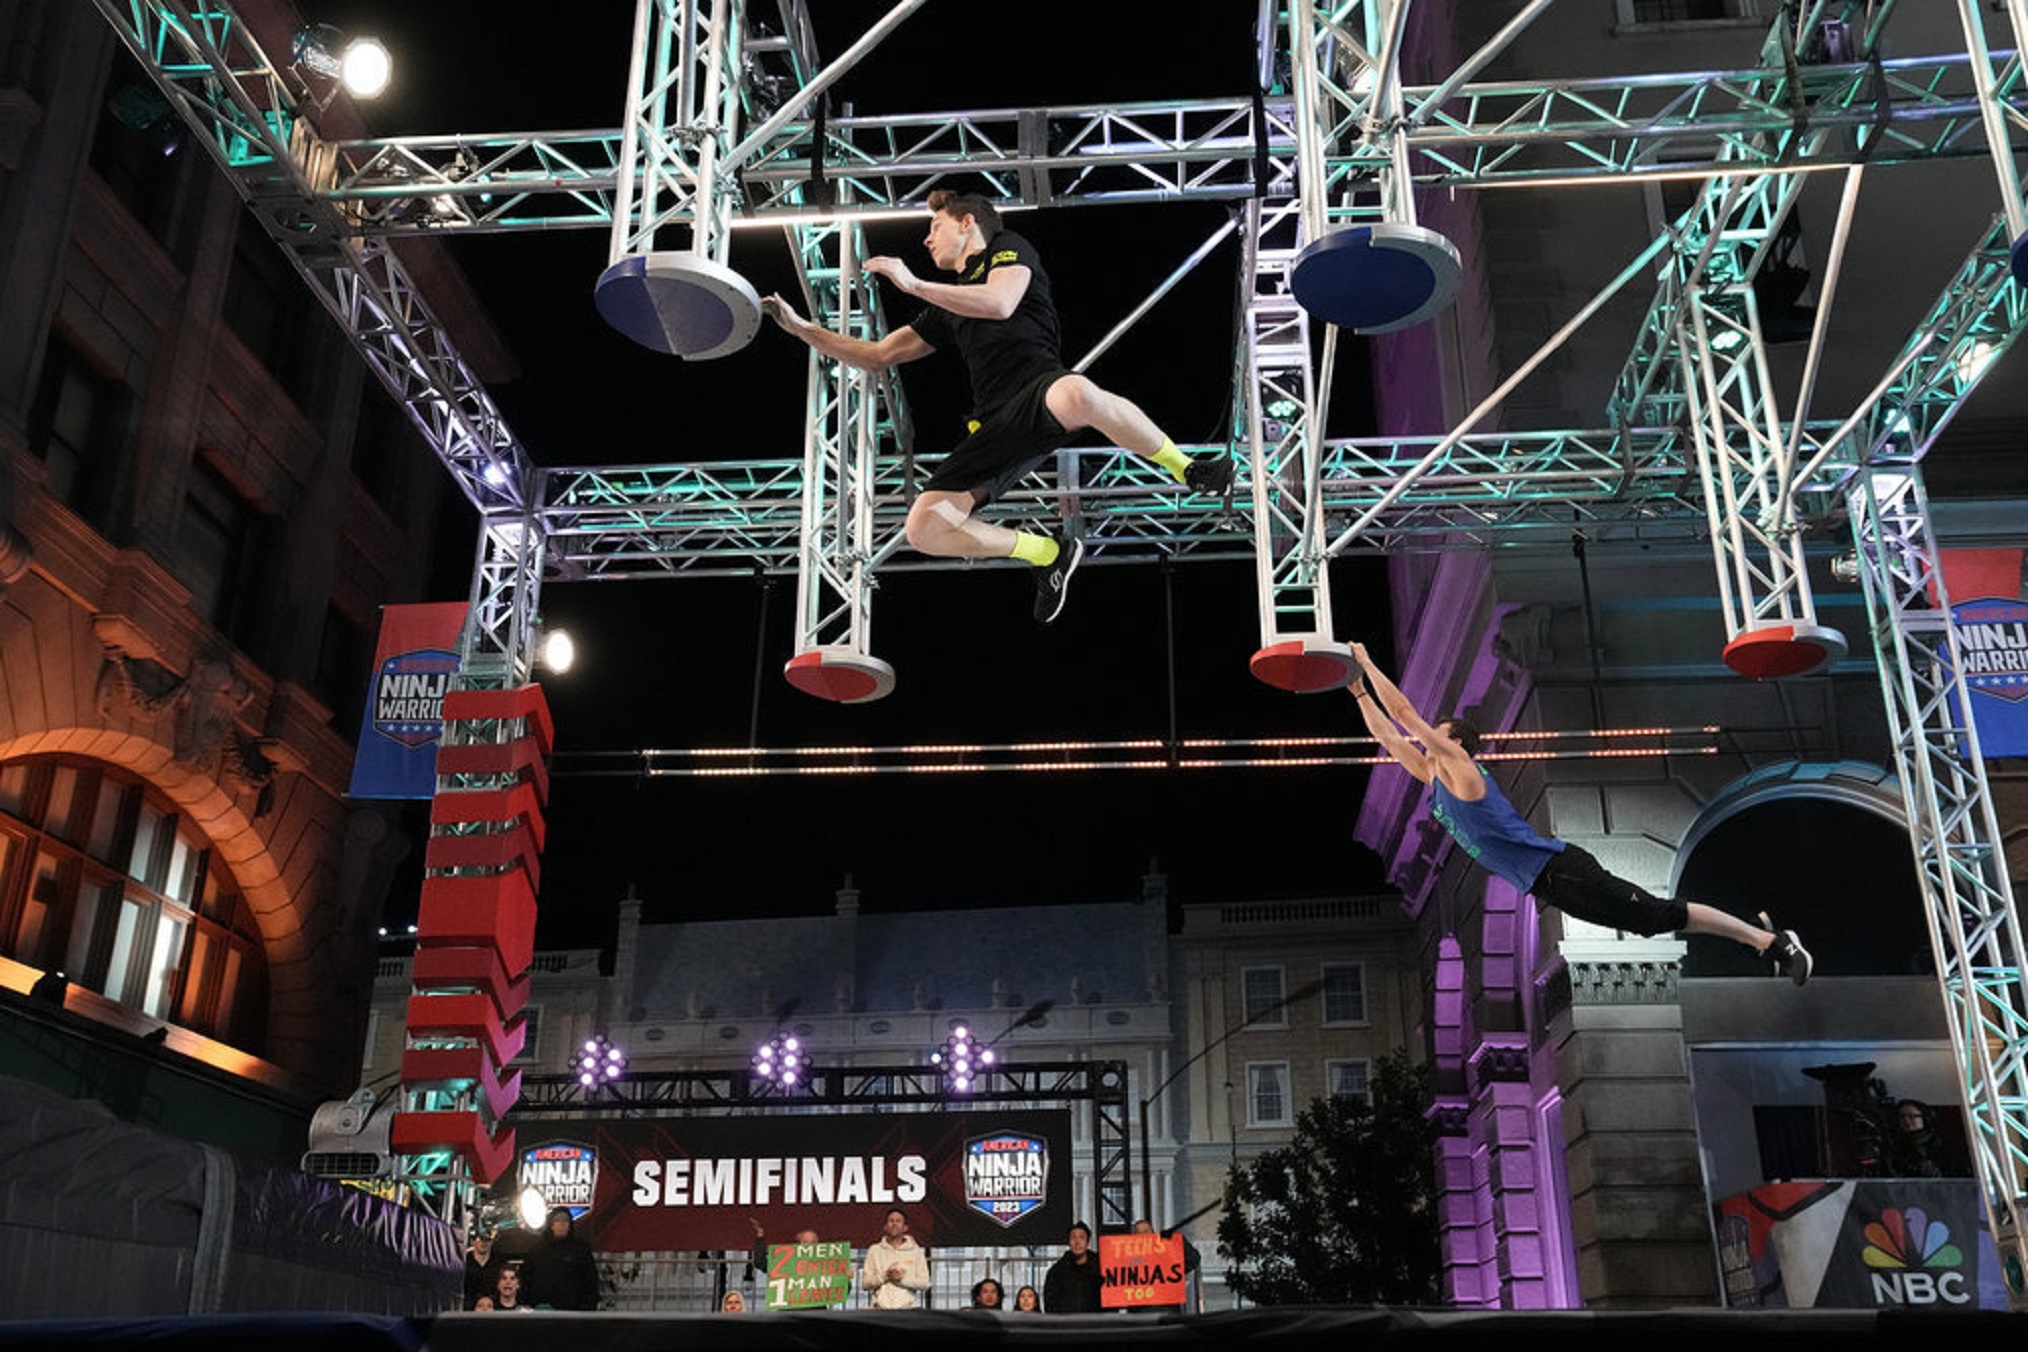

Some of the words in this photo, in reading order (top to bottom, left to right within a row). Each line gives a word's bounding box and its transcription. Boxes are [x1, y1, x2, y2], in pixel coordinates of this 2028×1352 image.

[1954, 622, 2028, 651] NINJ
[1962, 649, 2028, 673] WARRI
[380, 674, 447, 698] NINJ
[378, 699, 444, 719] WARRIO
[522, 1160, 591, 1185] NINJA
[968, 1151, 1042, 1177] NINJA
[632, 1155, 926, 1206] SEMIFINALS
[969, 1176, 1041, 1197] WARRIOR
[539, 1184, 590, 1203] RRIOR
[769, 1245, 794, 1278] 2
[797, 1243, 842, 1258] MEN
[796, 1258, 848, 1276] ENTER
[1105, 1263, 1183, 1288] NINJAS
[768, 1278, 789, 1307] 1
[788, 1275, 832, 1290] MAN
[789, 1286, 844, 1305] LEAVES
[1124, 1287, 1154, 1301] TOO
[1870, 1271, 1971, 1305] NBC
